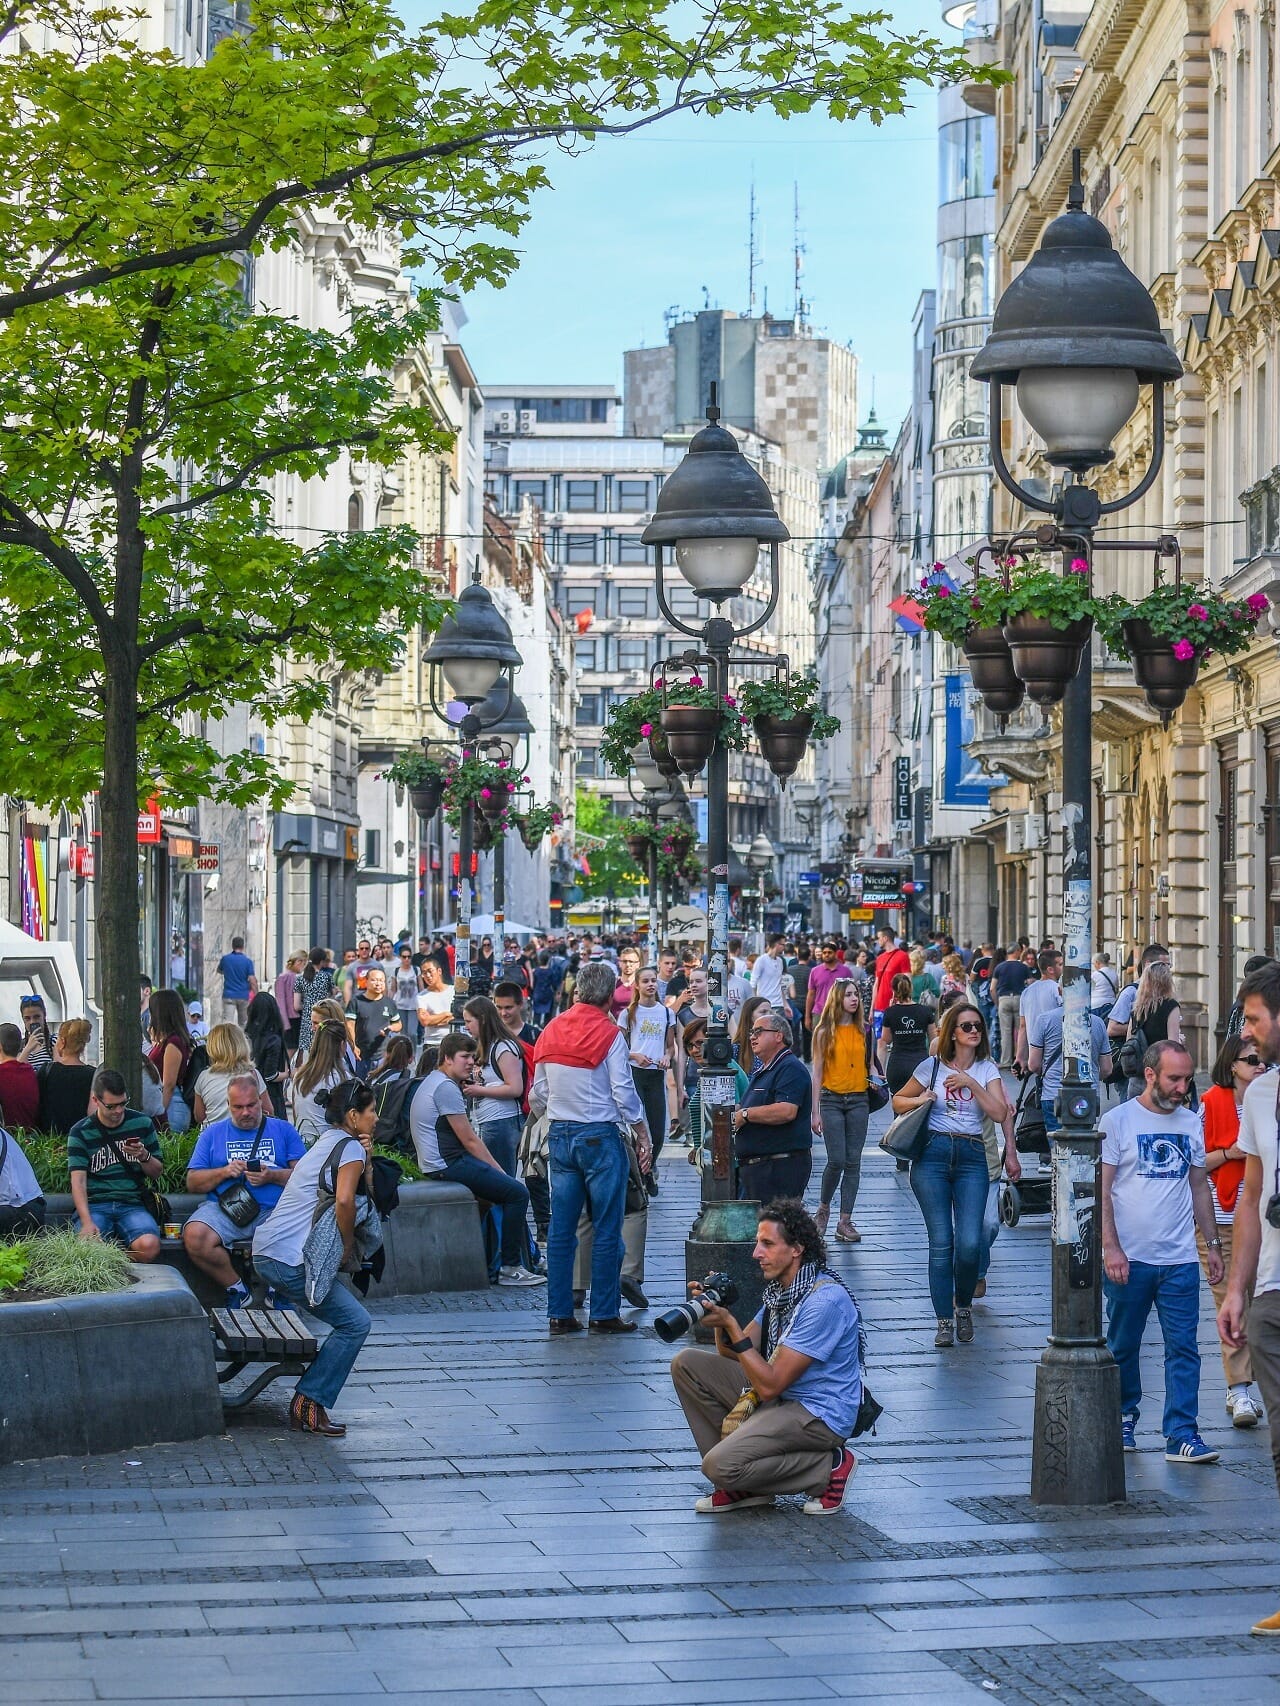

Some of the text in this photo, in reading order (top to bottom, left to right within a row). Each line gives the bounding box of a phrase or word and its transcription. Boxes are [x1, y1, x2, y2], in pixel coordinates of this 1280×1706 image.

[899, 759, 909, 819] HOTEL
[197, 859, 218, 870] SHOP
[91, 1147, 107, 1173] LOS
